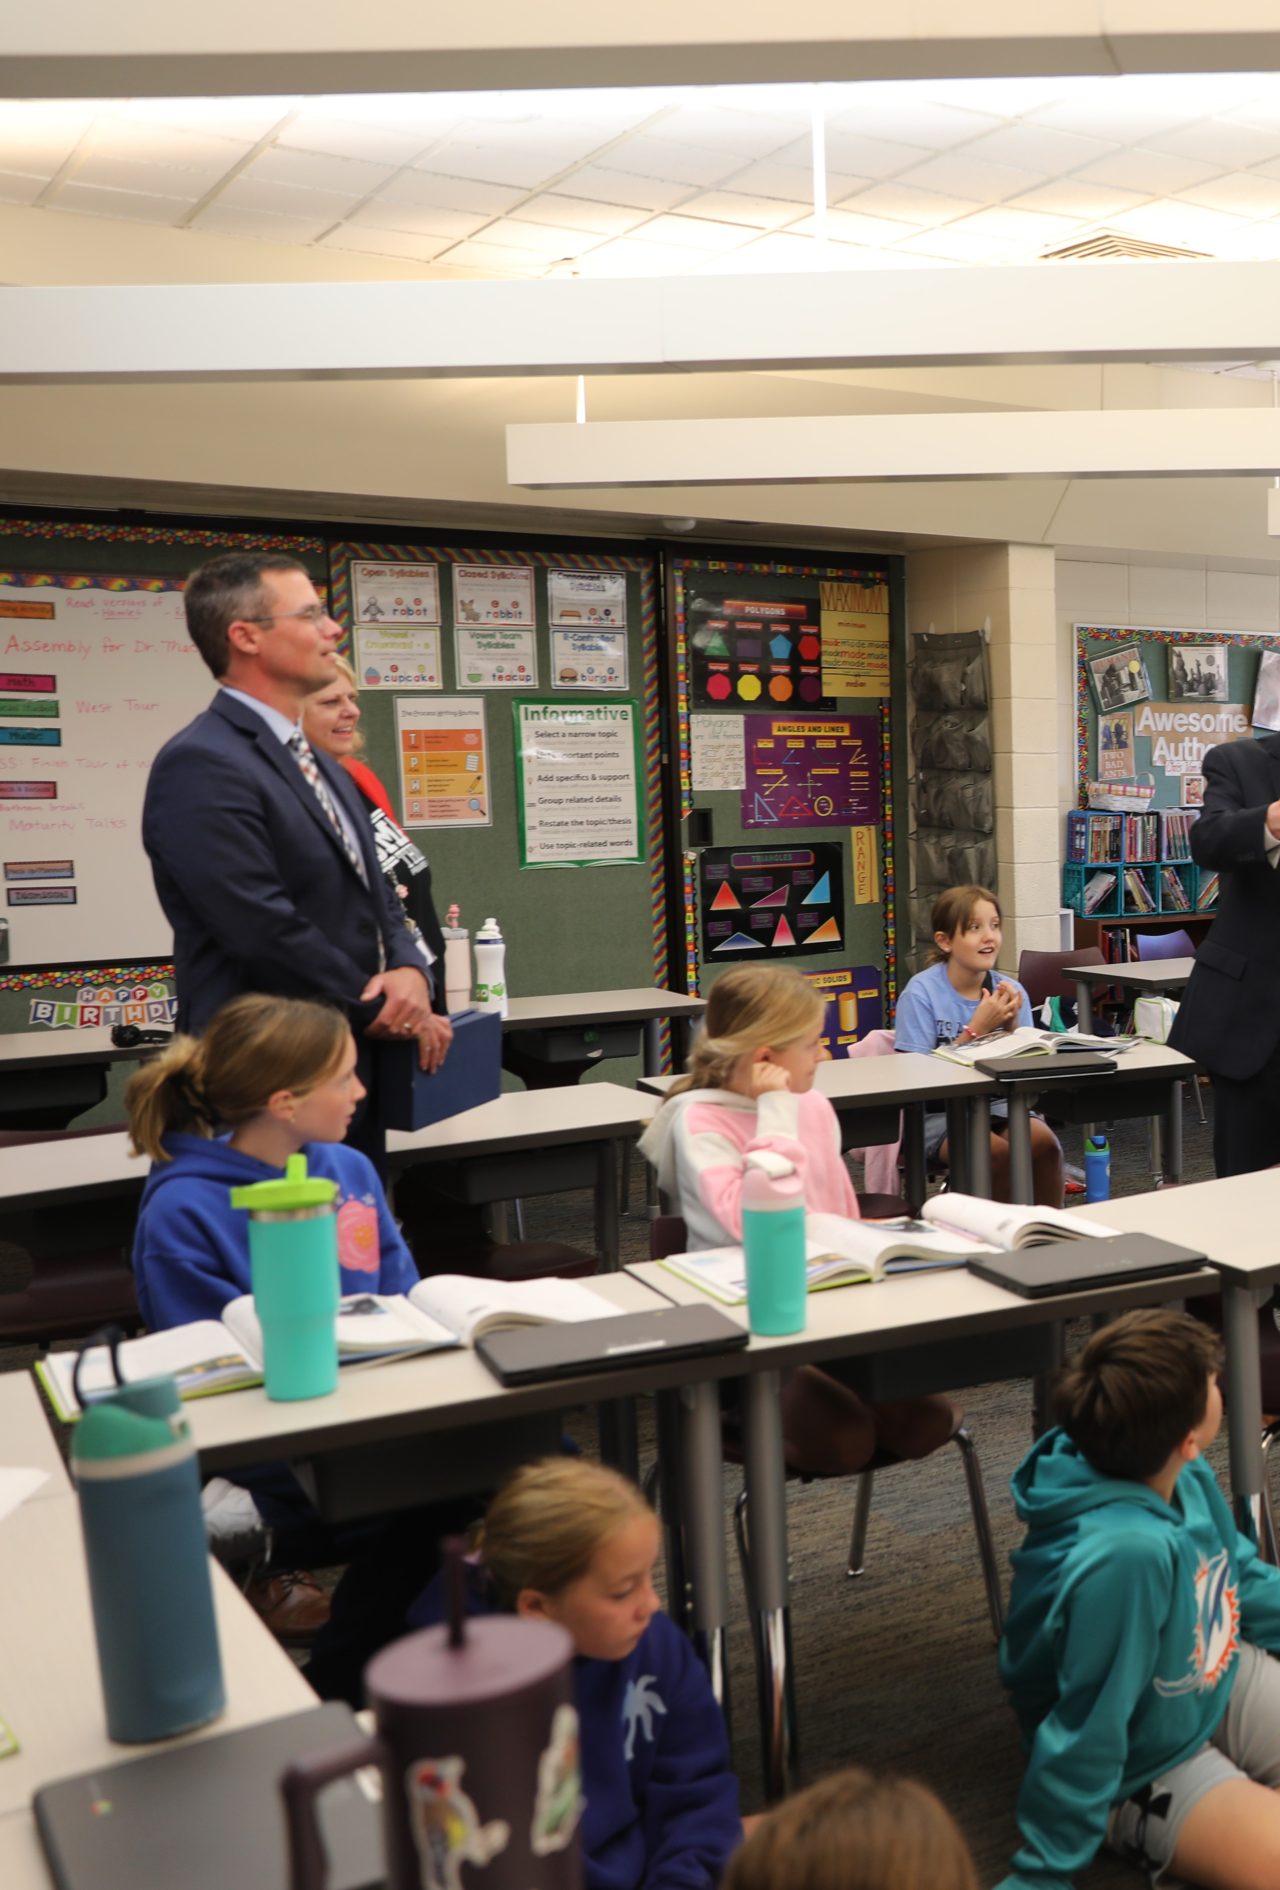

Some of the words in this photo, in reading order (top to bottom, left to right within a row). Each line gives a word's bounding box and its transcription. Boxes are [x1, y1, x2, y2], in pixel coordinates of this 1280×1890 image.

[392, 605, 428, 617] robot
[486, 609, 522, 619] rabbit
[744, 606, 786, 616] POLYGONS
[5, 634, 92, 660] Assembly
[103, 637, 124, 653] for
[841, 640, 866, 649] mode
[840, 650, 866, 660] mode
[384, 674, 435, 684] cupcake
[491, 672, 532, 683] teacup
[581, 674, 619, 684] burger
[75, 701, 112, 714] West
[122, 699, 160, 712] Tour
[524, 706, 629, 721] Informative
[1138, 707, 1248, 733] Awesome
[777, 725, 805, 733] ANGLES
[807, 725, 822, 733] AND
[824, 725, 845, 733] LINES
[9, 731, 42, 741] Music
[598, 730, 618, 739] topic
[594, 751, 620, 760] points
[1104, 752, 1124, 761] TWO
[1105, 760, 1124, 770] BAD
[555, 774, 589, 783] specifics
[598, 773, 630, 783] support
[538, 797, 564, 806] Group
[565, 796, 593, 804] related
[595, 794, 622, 803] details
[9, 819, 76, 834] Maturity
[84, 818, 128, 829] Talks
[538, 820, 569, 828] Restate
[570, 818, 584, 826] the
[609, 839, 633, 847] words
[751, 853, 793, 863] TRIANGLES
[855, 830, 868, 896] RANGE
[823, 975, 848, 984] SOLIDS
[81, 987, 163, 1002] HAPPY
